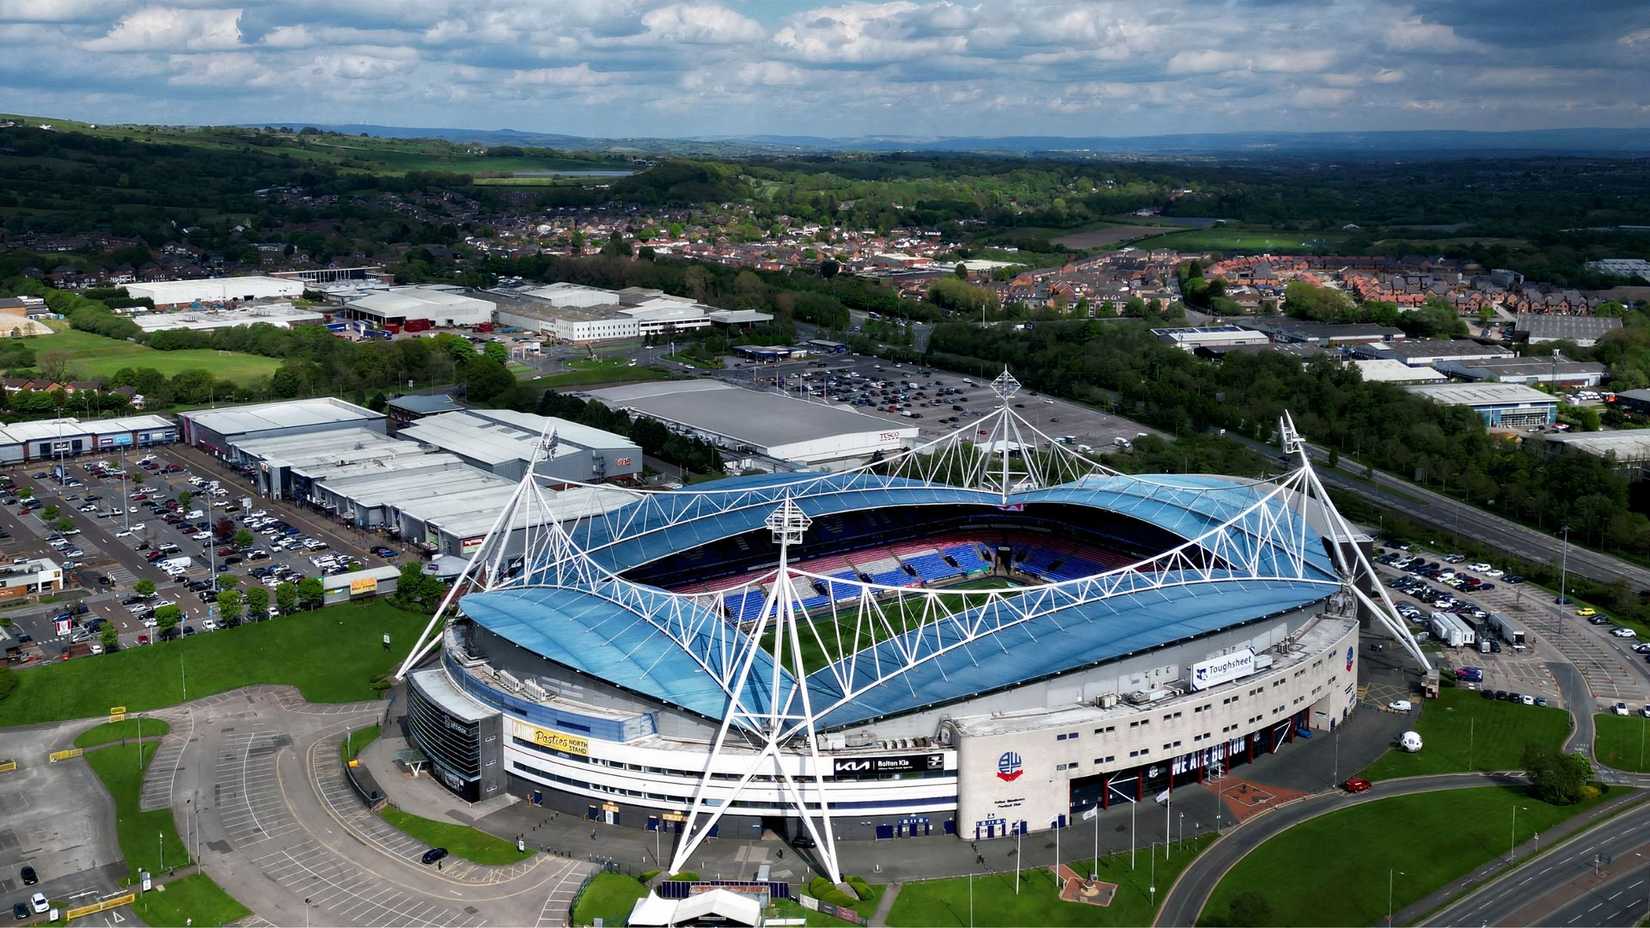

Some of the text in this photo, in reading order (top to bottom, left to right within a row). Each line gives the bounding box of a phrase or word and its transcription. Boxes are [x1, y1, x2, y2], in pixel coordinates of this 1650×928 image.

[1210, 656, 1252, 673] Toughsheet
[536, 731, 568, 746] Pasties
[1172, 756, 1187, 775] WE
